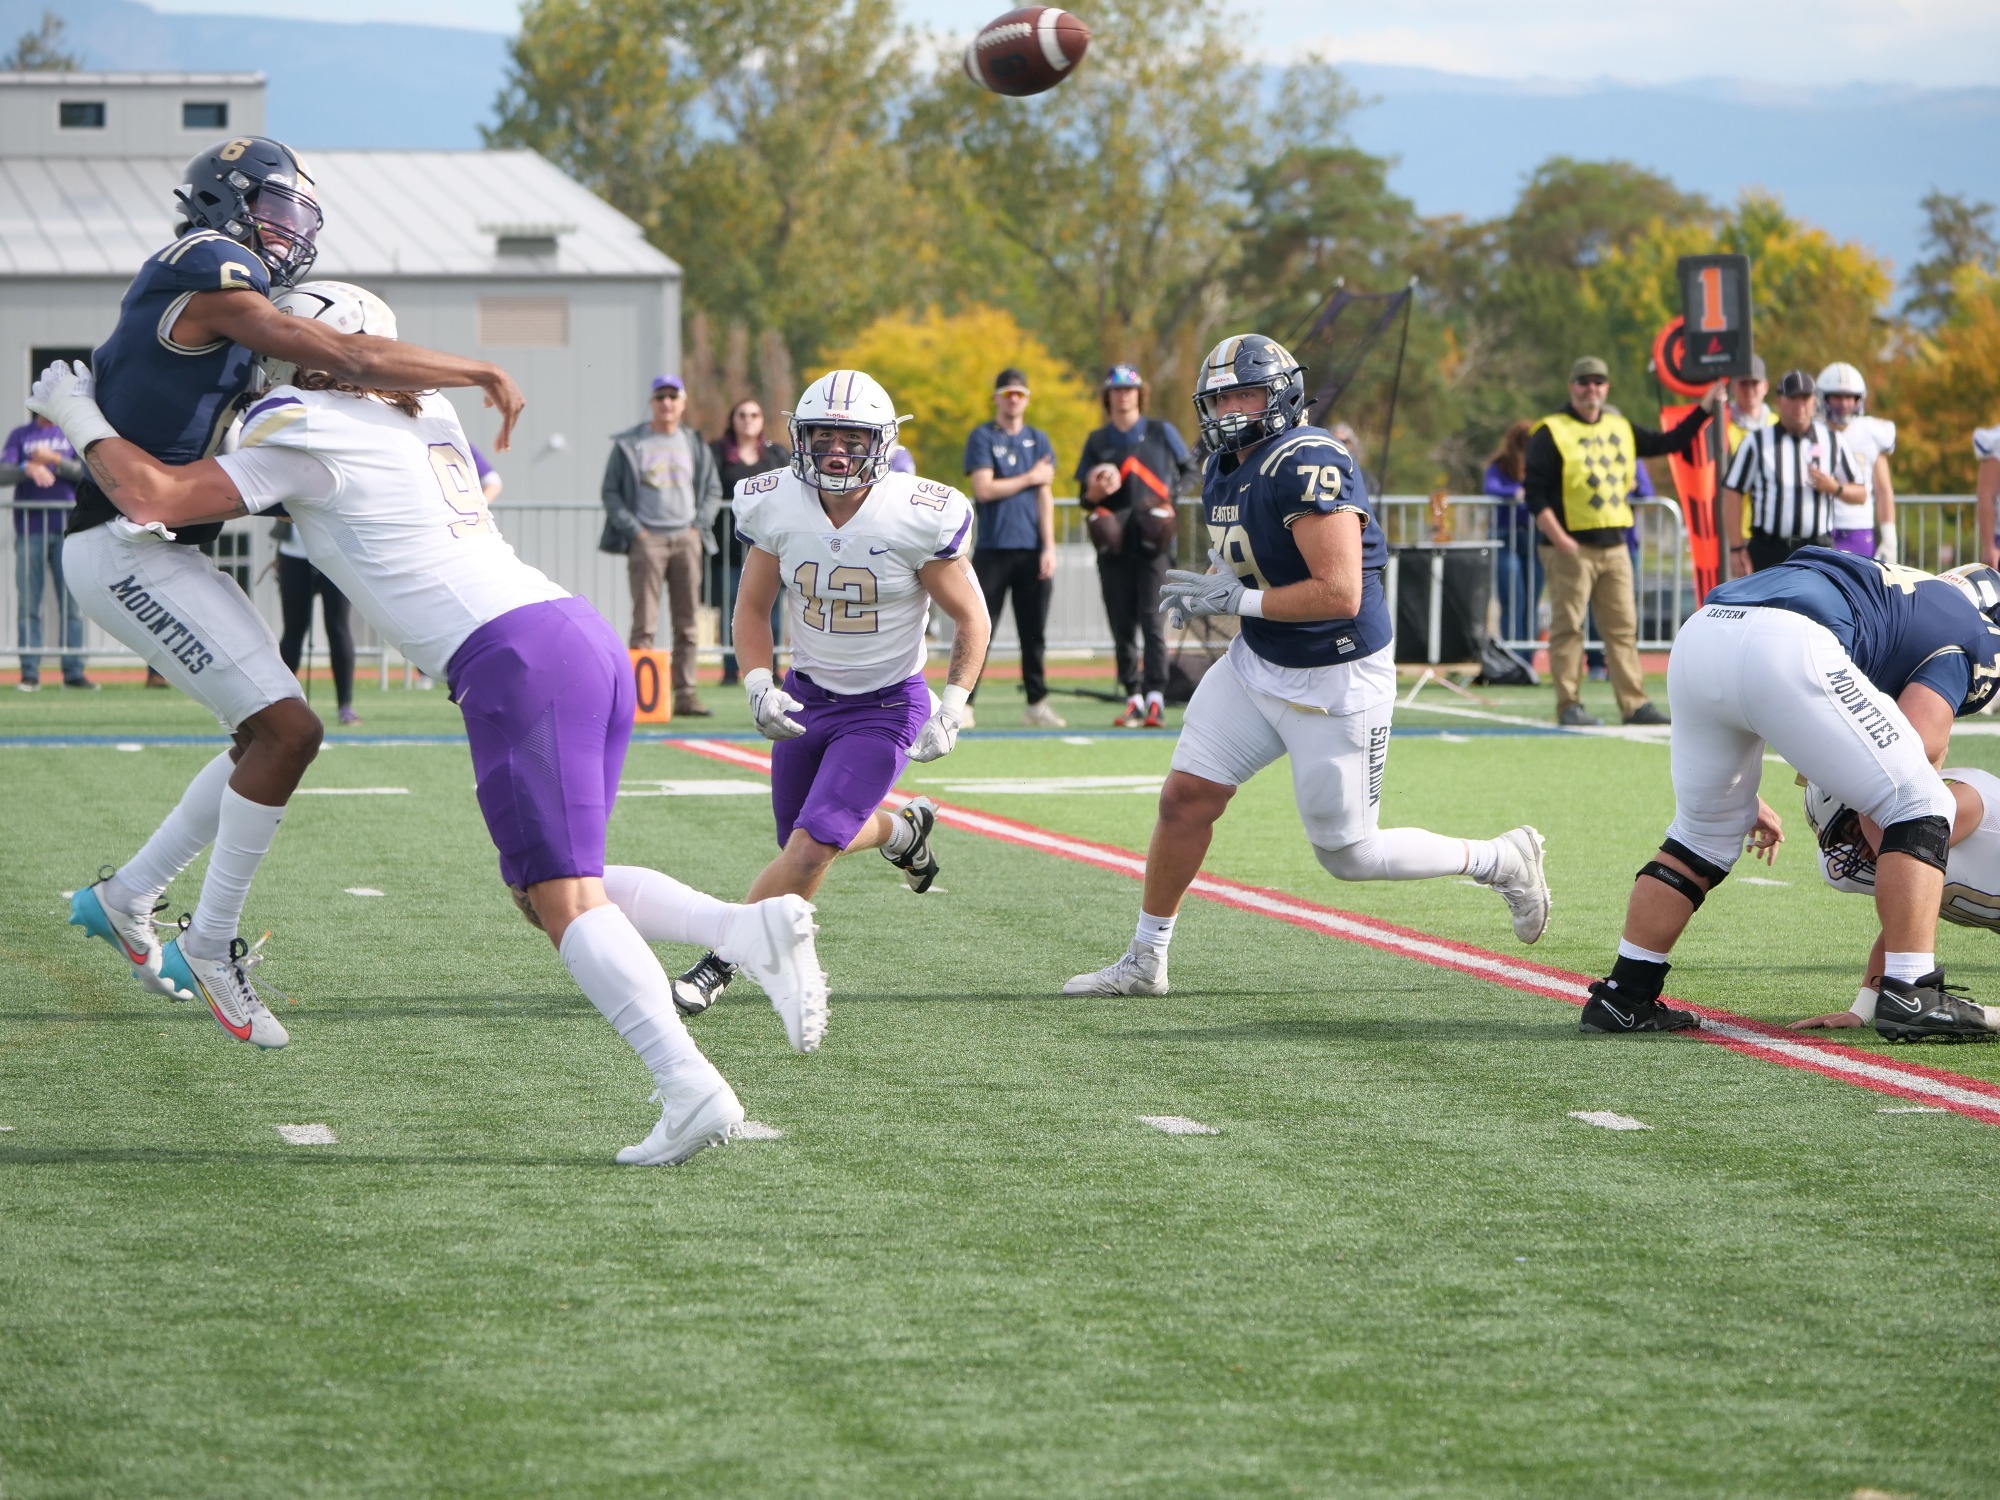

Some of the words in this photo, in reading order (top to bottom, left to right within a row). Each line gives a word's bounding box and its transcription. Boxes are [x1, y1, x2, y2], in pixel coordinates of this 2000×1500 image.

[219, 139, 252, 161] 6
[1699, 266, 1727, 332] 1
[910, 481, 953, 512] 12
[1297, 465, 1342, 502] 79
[1211, 505, 1240, 523] EASTERN
[793, 560, 879, 635] 12
[1706, 608, 1748, 620] EASTERN
[109, 574, 214, 676] MOUNTIES
[1335, 636, 1352, 647] 2XL
[1825, 668, 1901, 750] MOUNTIES
